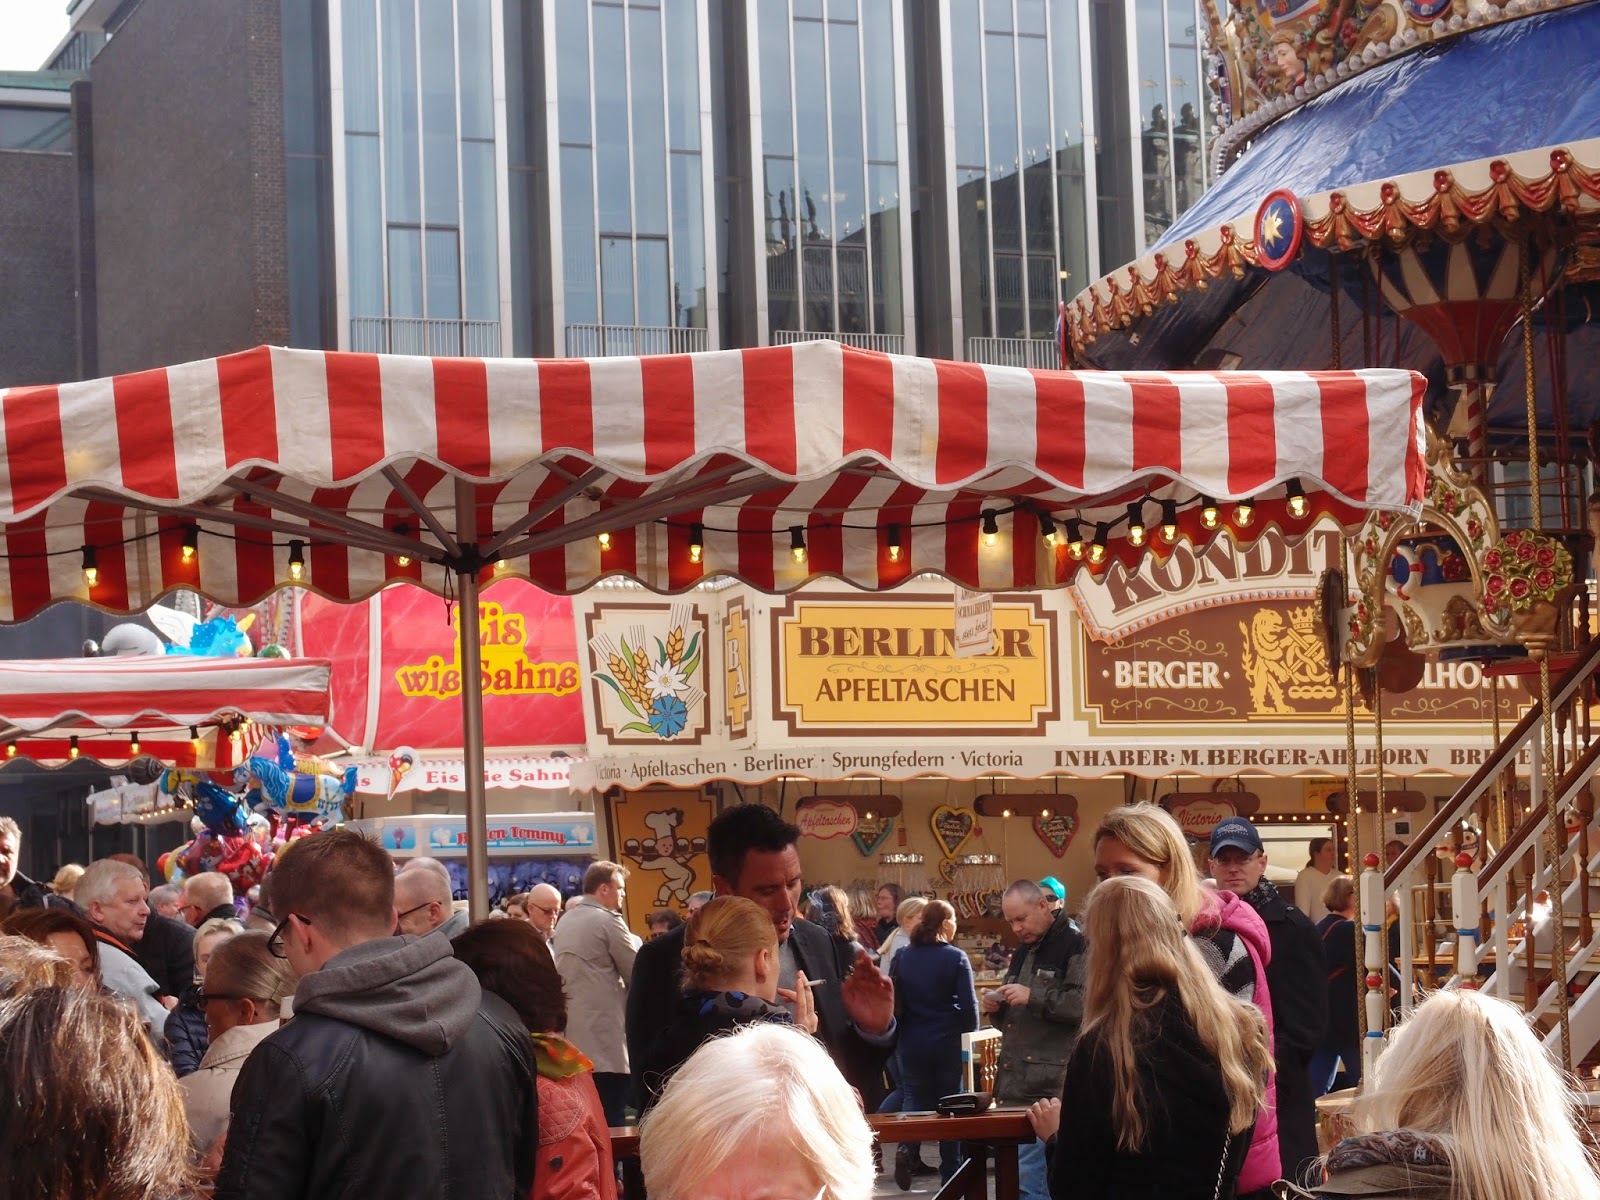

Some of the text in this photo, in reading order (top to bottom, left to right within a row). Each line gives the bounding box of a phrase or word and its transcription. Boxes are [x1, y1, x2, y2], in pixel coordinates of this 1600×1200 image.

[1106, 528, 1353, 614] KONDIT
[480, 606, 522, 647] is
[401, 660, 460, 695] wie
[1115, 660, 1224, 689] BERGER
[815, 678, 1015, 702] APFELTASCHEN
[630, 757, 727, 782] Apfeltaschen
[743, 753, 814, 772] Berliner
[832, 750, 944, 772] Sprungfedern
[960, 750, 1024, 767] Victoria
[1053, 749, 1175, 767] INHABER:
[426, 770, 459, 784] Eis
[1178, 808, 1223, 826] Victoria
[510, 825, 567, 846] Tommy
